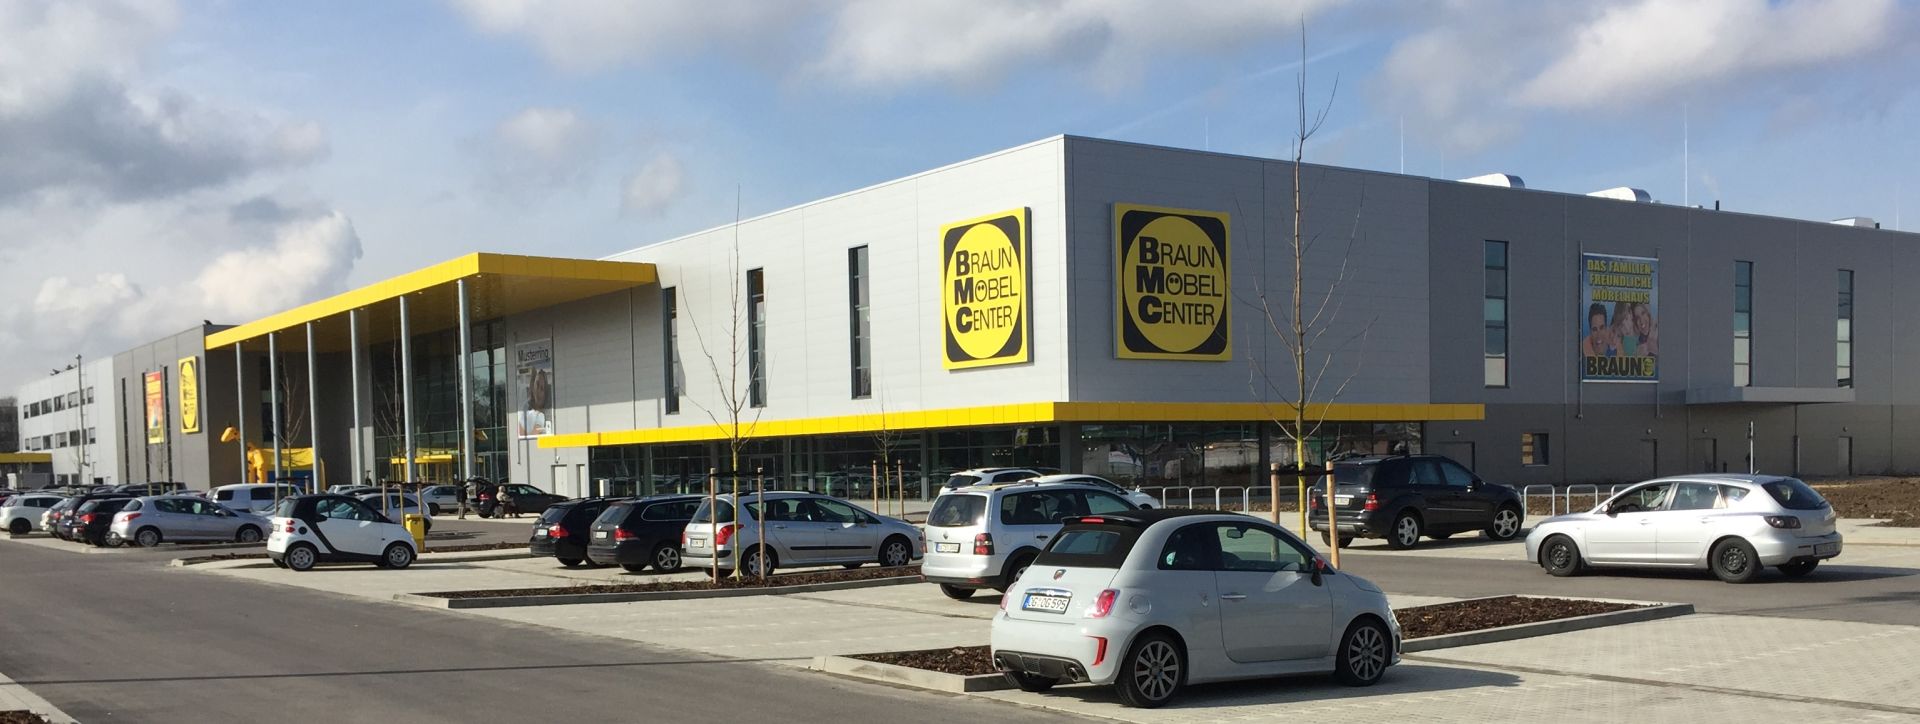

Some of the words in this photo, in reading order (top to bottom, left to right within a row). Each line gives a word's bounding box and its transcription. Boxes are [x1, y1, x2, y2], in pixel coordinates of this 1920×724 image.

[955, 245, 1012, 277] BRAUN
[1139, 236, 1215, 268] BRAUN
[1587, 259, 1606, 272] DAS
[954, 275, 1018, 306] MÖBEL
[1136, 265, 1222, 297] MÖBEL
[1589, 273, 1652, 289] FREUNDLICHE
[1592, 287, 1650, 303] MÖBELHAUS
[955, 305, 1013, 334] CENTER
[1138, 295, 1215, 326] CENTER
[1586, 356, 1642, 376] BRAUN
